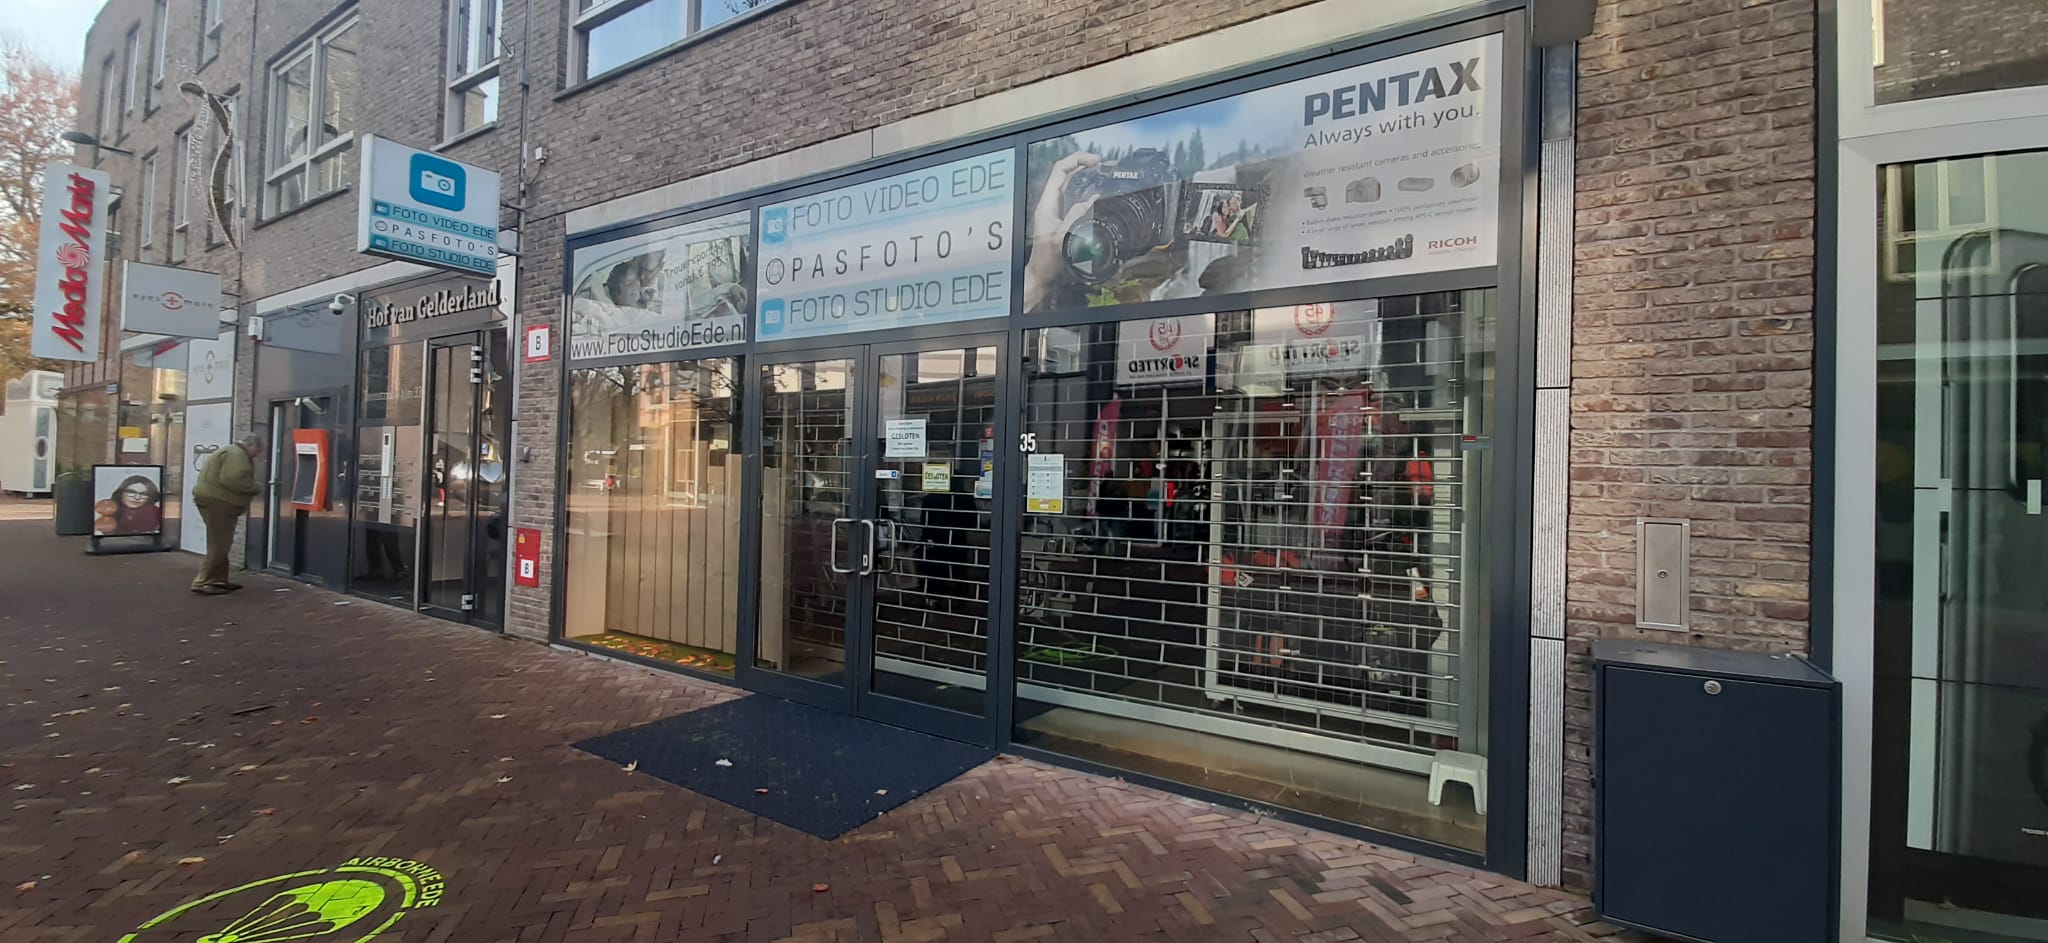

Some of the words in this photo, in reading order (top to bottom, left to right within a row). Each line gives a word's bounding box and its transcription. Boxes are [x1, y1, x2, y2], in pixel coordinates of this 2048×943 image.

[1304, 57, 1481, 126] PENTAX
[1304, 125, 1371, 148] Always
[1379, 111, 1425, 134] with
[1433, 104, 1480, 128] you.
[1411, 150, 1428, 160] and
[793, 196, 852, 230] FOTO
[864, 176, 939, 215] VIDEO
[952, 160, 1005, 198] EDE
[392, 207, 427, 222] FOTO
[433, 216, 468, 233] VIDEO
[473, 226, 495, 239] EDE
[391, 240, 425, 255] FOTO
[428, 248, 469, 265] STUDIO
[473, 258, 493, 270] EDE
[392, 225, 494, 256] PASFOTO'S
[1428, 236, 1477, 249] RICOH
[367, 304, 393, 328] Hof
[390, 308, 414, 324] van
[417, 278, 501, 319] Gelderland
[790, 295, 846, 324] FOTO
[854, 280, 941, 317] STUDIO
[951, 271, 1003, 305] EDE
[535, 335, 541, 351] B
[571, 316, 746, 359] www.FotoStudioEde.nl
[891, 432, 920, 440] GESLOTEN
[1019, 433, 1036, 451] 35
[524, 562, 529, 574] B
[340, 857, 443, 885] AIRBORNE
[414, 882, 445, 909] EDE
